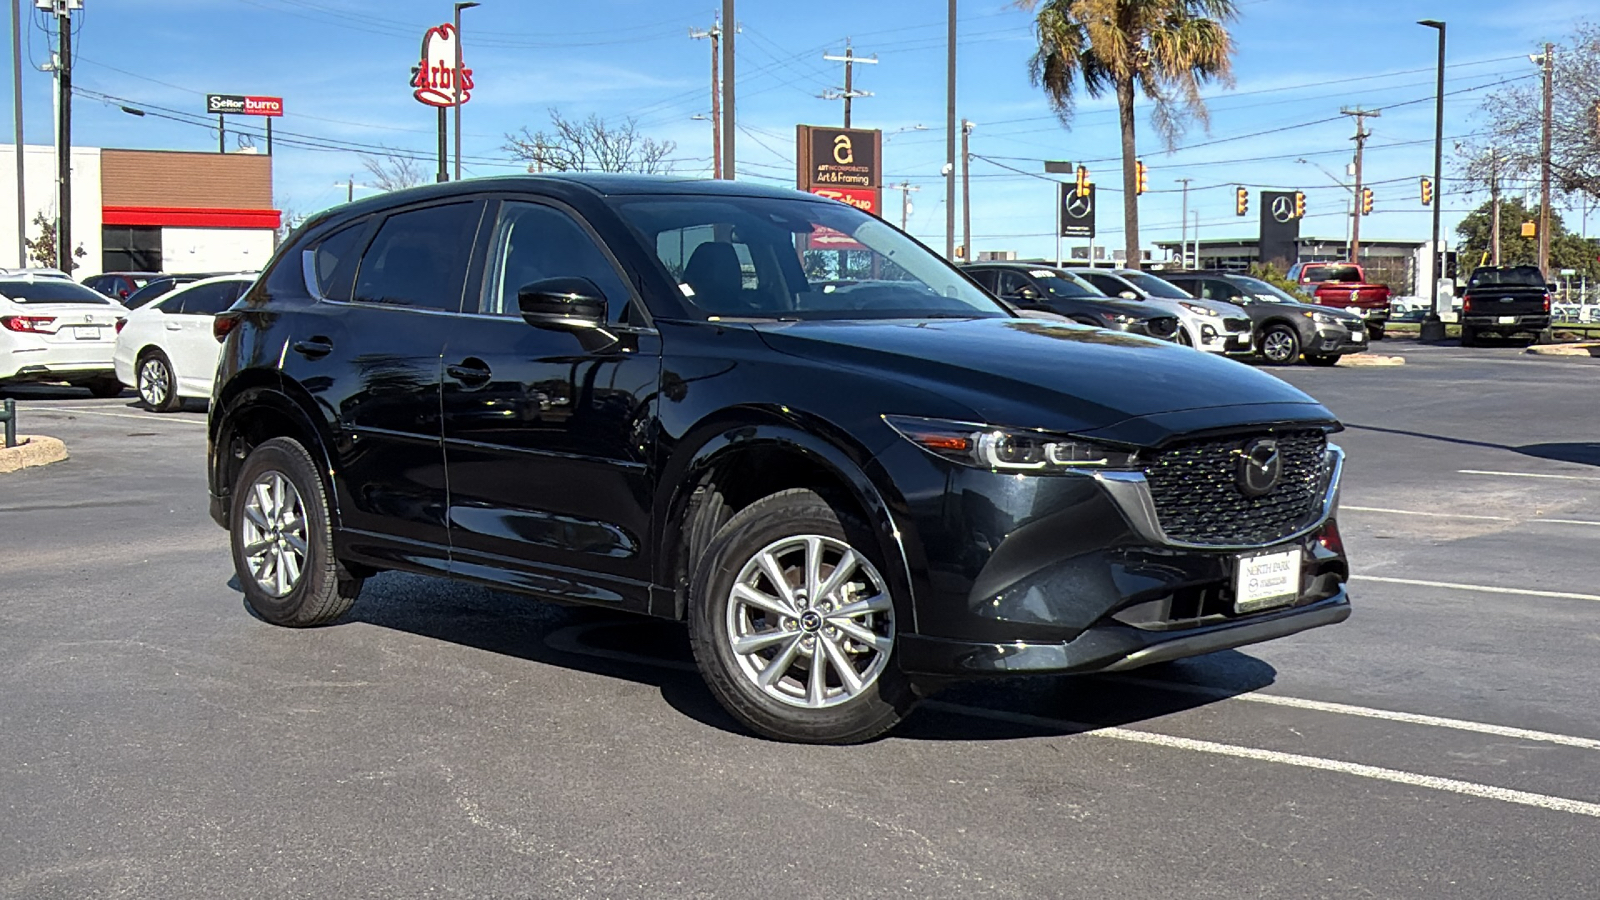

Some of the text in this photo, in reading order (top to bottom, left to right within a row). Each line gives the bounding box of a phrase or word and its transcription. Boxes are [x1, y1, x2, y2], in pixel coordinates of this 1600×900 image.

[245, 97, 280, 110] burro
[817, 172, 869, 186] Art & Framing
[1246, 563, 1272, 577] NORTH
